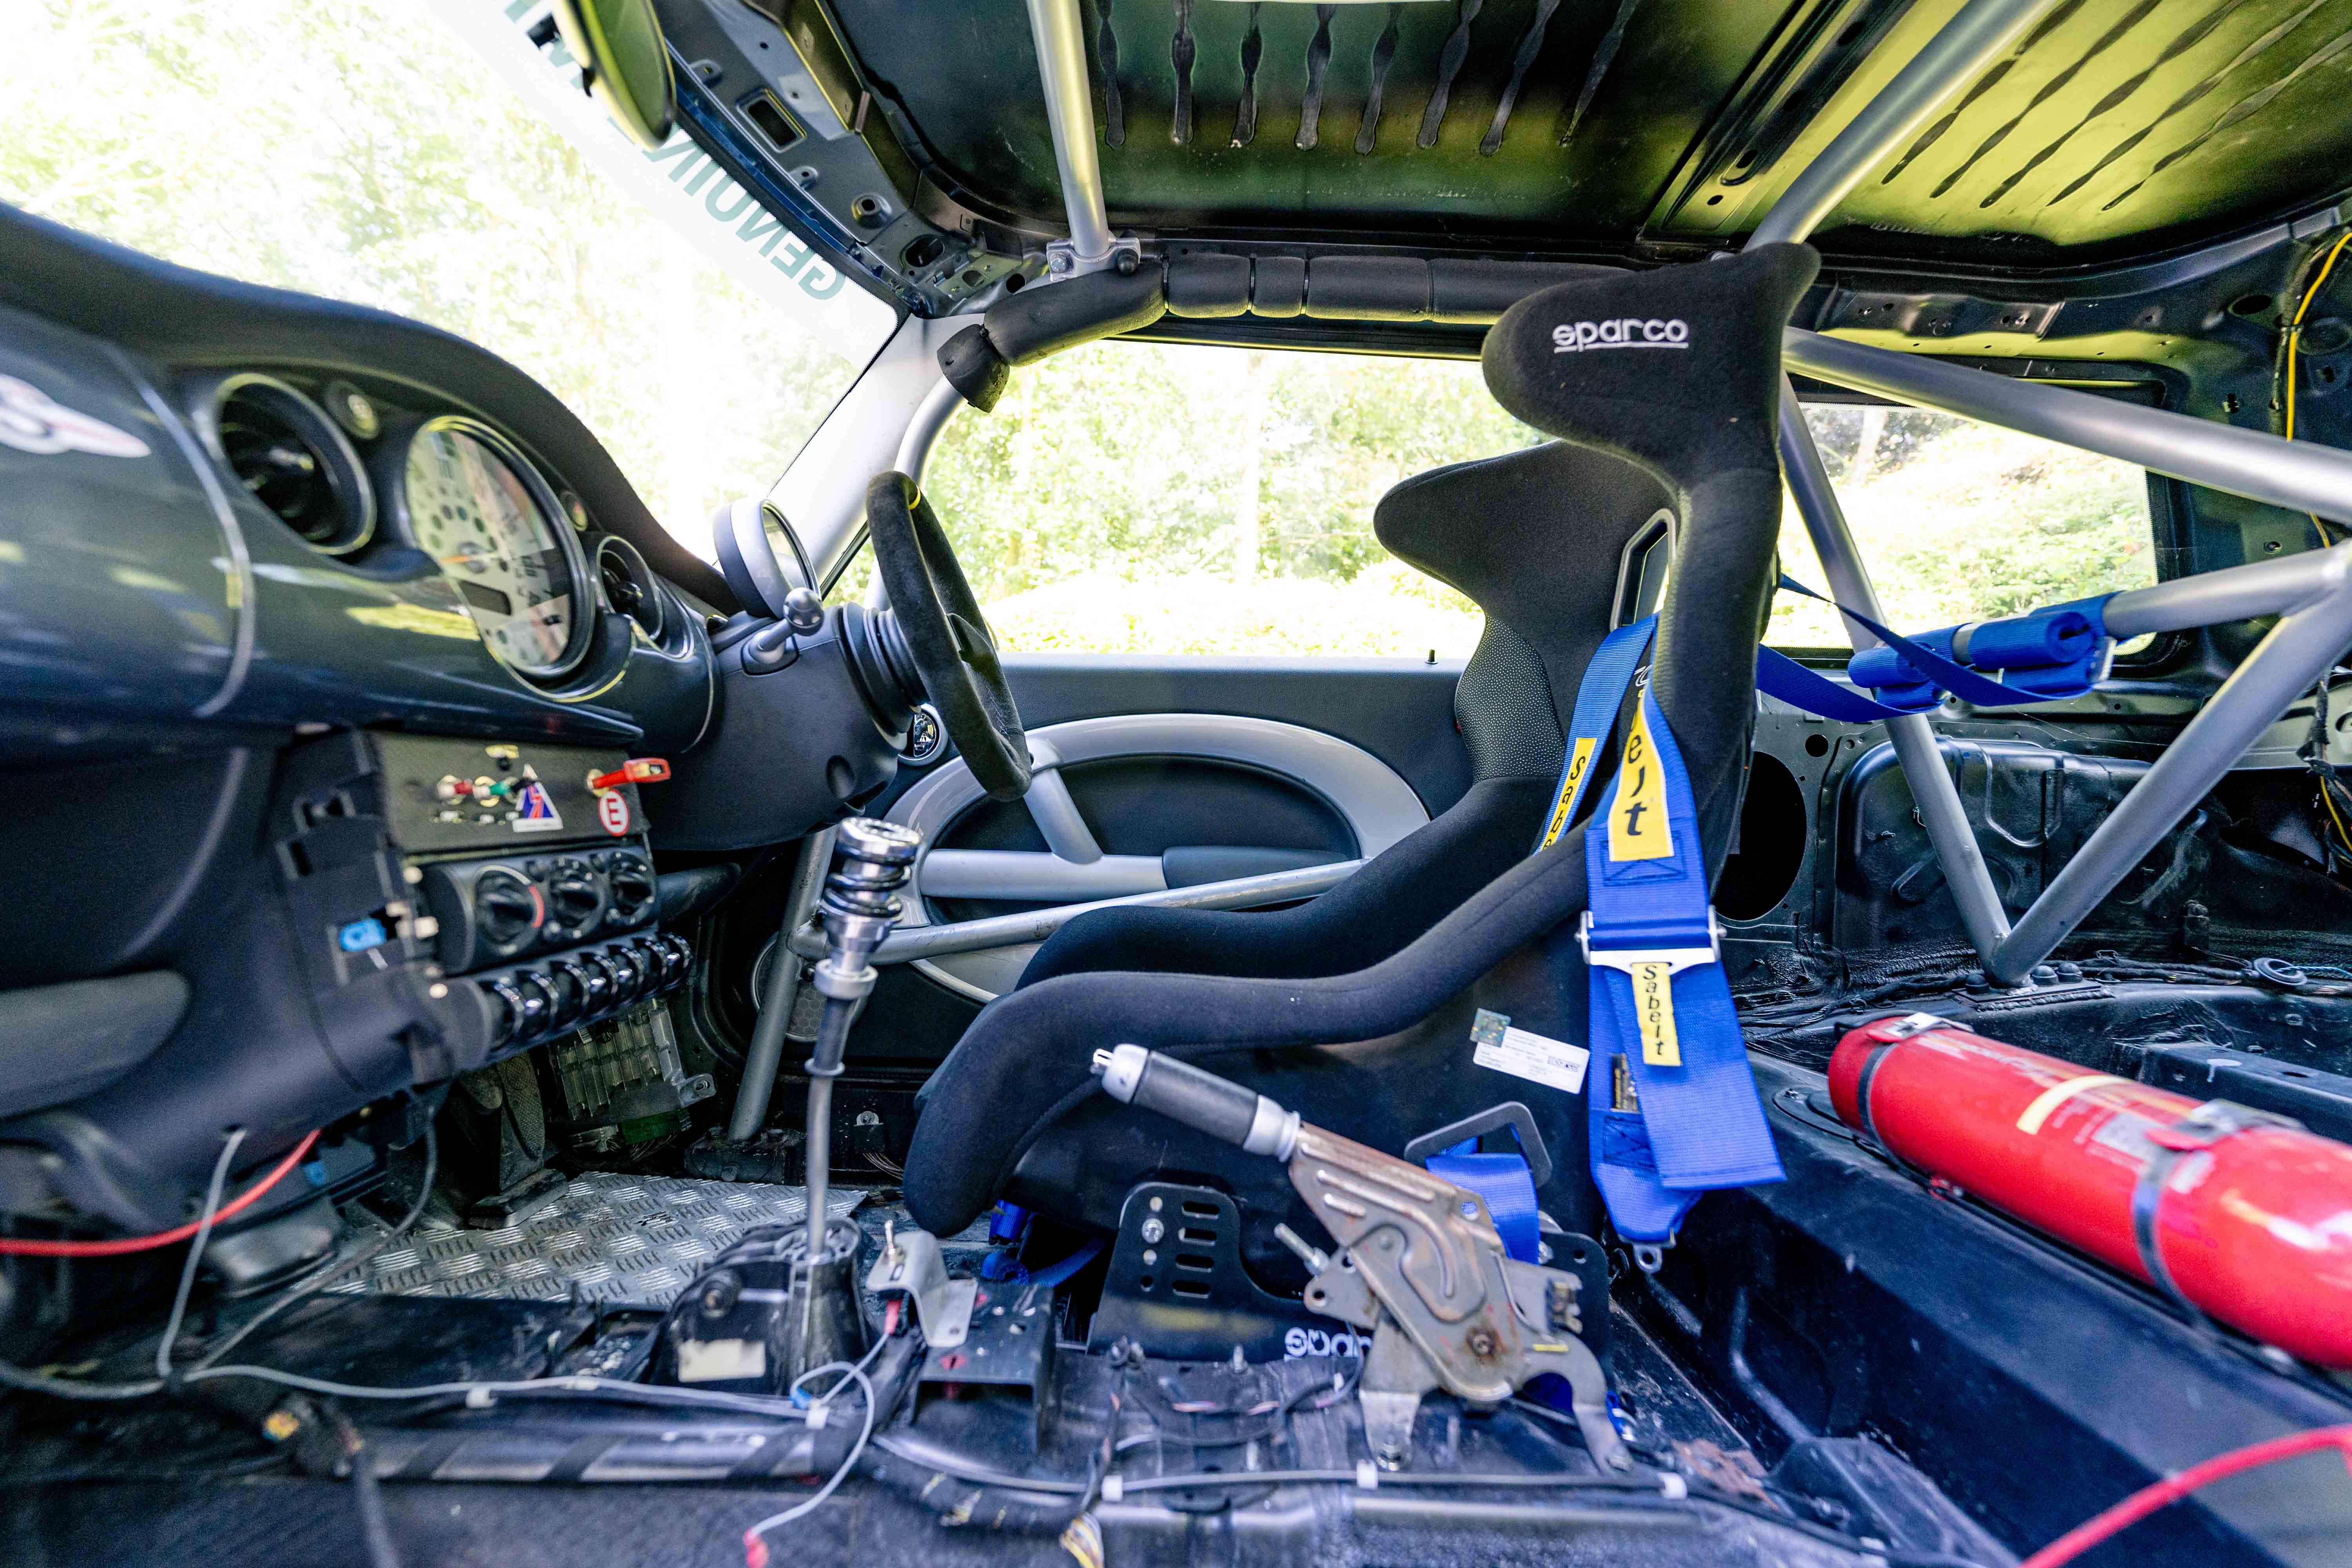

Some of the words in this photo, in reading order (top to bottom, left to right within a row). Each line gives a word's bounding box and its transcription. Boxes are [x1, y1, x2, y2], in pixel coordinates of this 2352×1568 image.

[1552, 319, 1689, 353] sparco
[606, 798, 621, 826] E
[1543, 756, 1586, 849] Sabe
[1643, 965, 1664, 1055] Sabelt
[1284, 1327, 1372, 1357] spar
